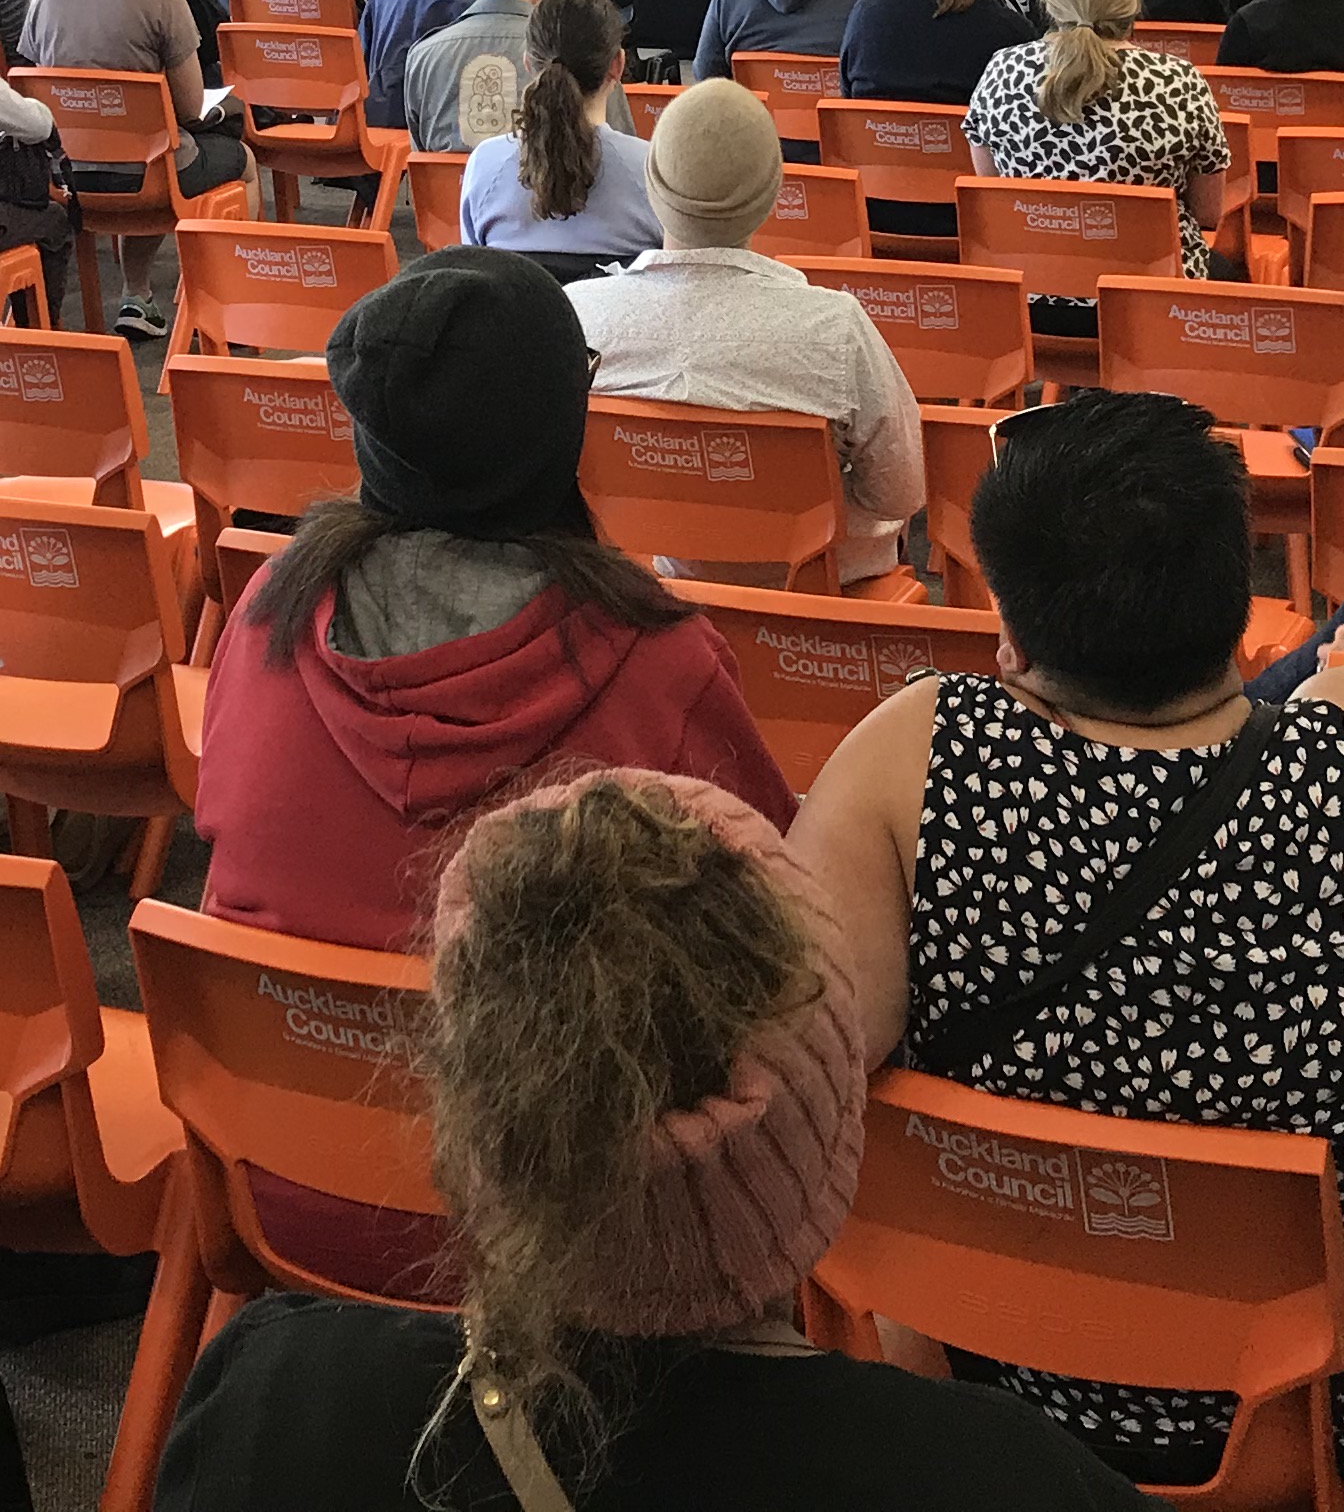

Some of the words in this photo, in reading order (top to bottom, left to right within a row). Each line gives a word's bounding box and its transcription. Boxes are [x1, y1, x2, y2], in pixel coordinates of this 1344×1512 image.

[269, 2, 298, 12] Council
[256, 39, 296, 49] Auckland
[264, 48, 297, 59] Council
[774, 69, 820, 82] Auckland
[51, 86, 96, 97] Auckland
[783, 79, 822, 90] Council
[1220, 84, 1274, 99] Auckland
[60, 97, 96, 108] Council
[1230, 96, 1274, 108] Council
[866, 120, 918, 134] Auckland
[876, 132, 920, 145] Council
[1013, 200, 1079, 217] Auckland
[1026, 214, 1080, 230] Council
[234, 244, 296, 263] Auckland
[247, 260, 299, 278] Council
[861, 301, 916, 318] ouncil
[1168, 303, 1249, 326] Auckland
[1185, 321, 1250, 341] Council
[244, 388, 323, 410] Auckland
[260, 407, 325, 428] Council
[614, 429, 699, 450] Auckland
[631, 445, 703, 468] Council
[755, 626, 869, 660] Auckland
[778, 651, 871, 682] Council
[257, 973, 395, 1027] Auckland
[905, 1115, 1070, 1180] Auckland
[938, 1153, 1074, 1209] Council
